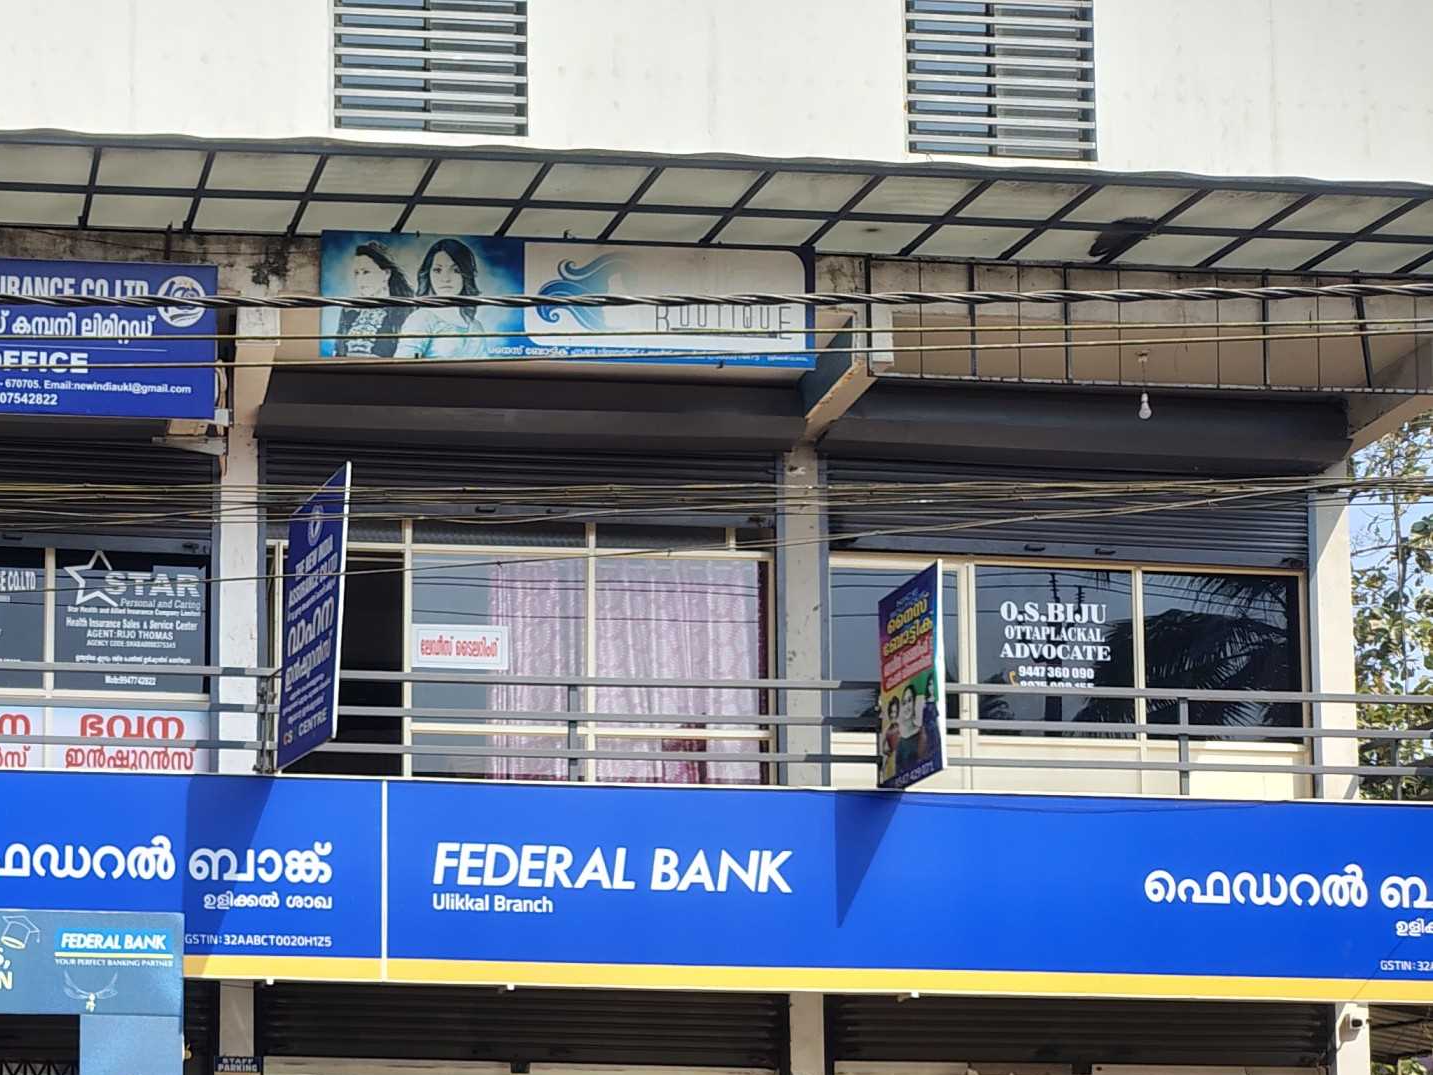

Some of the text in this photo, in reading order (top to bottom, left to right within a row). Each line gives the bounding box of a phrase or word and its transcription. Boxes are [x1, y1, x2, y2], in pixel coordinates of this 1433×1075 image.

[105, 572, 201, 598] STAR
[120, 597, 202, 611] Personal and Caring
[1000, 600, 1107, 624] O.S.BIJU
[66, 617, 174, 630] Health Insurance Sales Service
[138, 631, 174, 641] THOMAS
[1004, 625, 1106, 643] OTTAPLACKAL
[999, 642, 1112, 662] ADVOCATE
[1018, 665, 1095, 679] 9447 360 090
[187, 840, 333, 884] ബാങ്ക്
[432, 842, 794, 894] FEDERAL BANK
[1143, 863, 1369, 909] ഫെഡറൽ
[203, 890, 333, 910] ഉളിക്കൽ ശാഖ
[432, 892, 554, 914] Ulikkal Branch
[61, 932, 167, 950] FEDERAL BANK
[55, 957, 174, 968] YOUR PERFECT BANKING PARTNER
